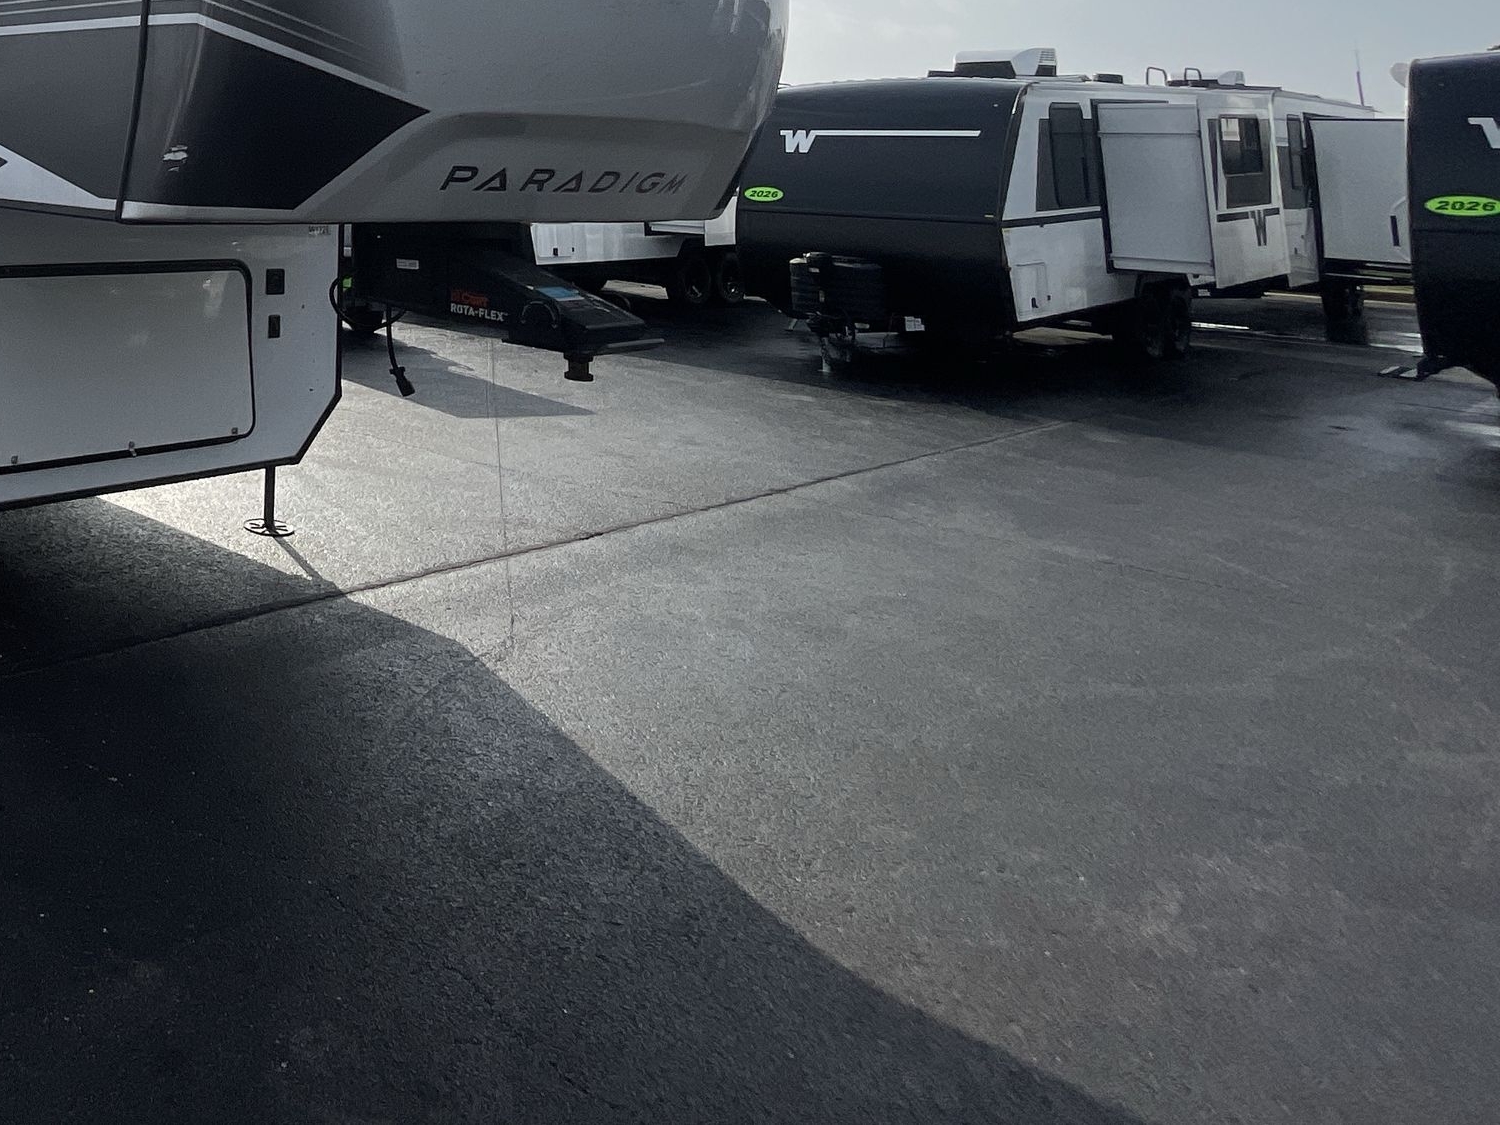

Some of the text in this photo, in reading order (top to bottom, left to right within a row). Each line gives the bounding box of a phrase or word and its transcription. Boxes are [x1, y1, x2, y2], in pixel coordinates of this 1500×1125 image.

[439, 165, 688, 195] PARADIGM
[749, 189, 779, 199] 2026
[1434, 200, 1497, 211] 2026
